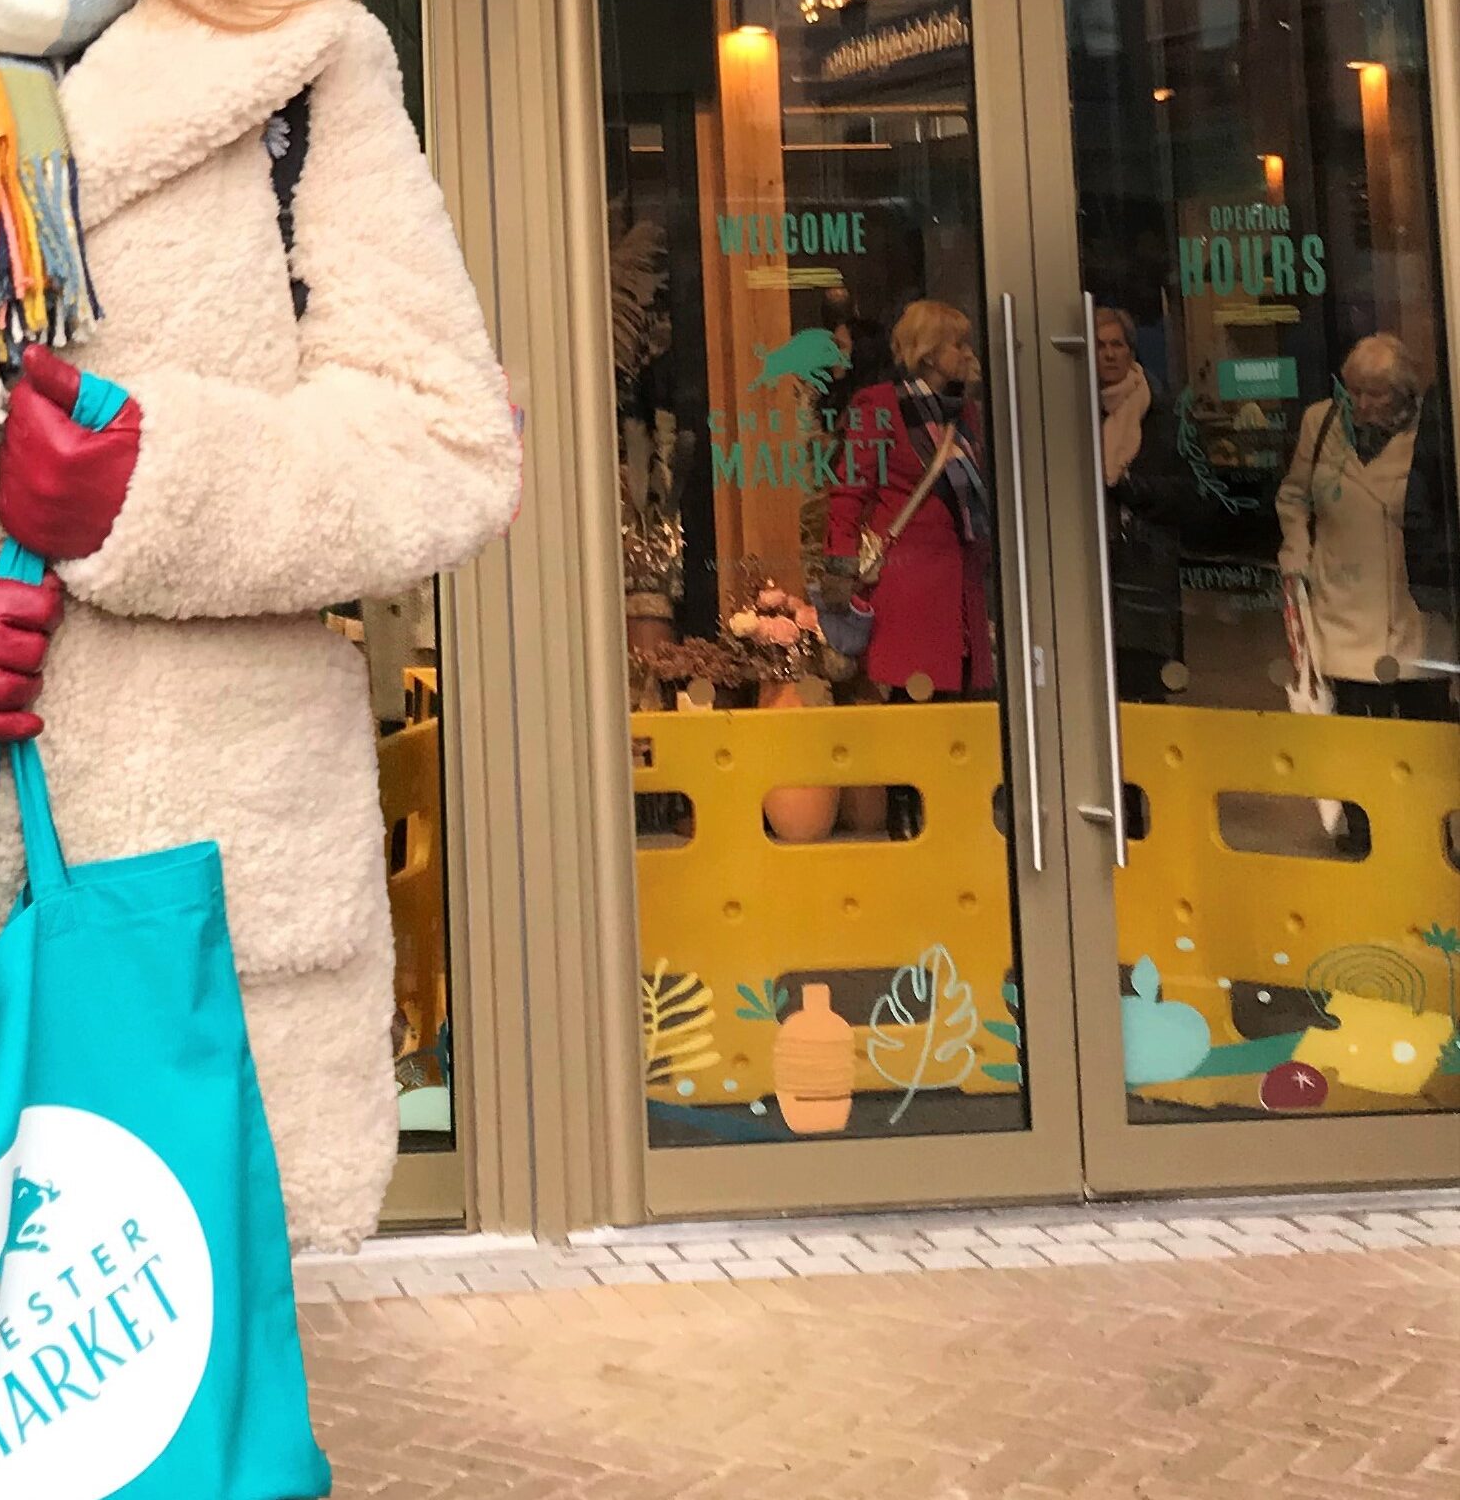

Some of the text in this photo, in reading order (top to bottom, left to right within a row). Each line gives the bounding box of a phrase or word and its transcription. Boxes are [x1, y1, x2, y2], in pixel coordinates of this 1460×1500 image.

[717, 211, 867, 256] WELCOME
[1211, 204, 1291, 231] OPENING
[1179, 233, 1327, 297] HOURS
[707, 408, 894, 434] CHESTER
[711, 438, 896, 496] MARKET
